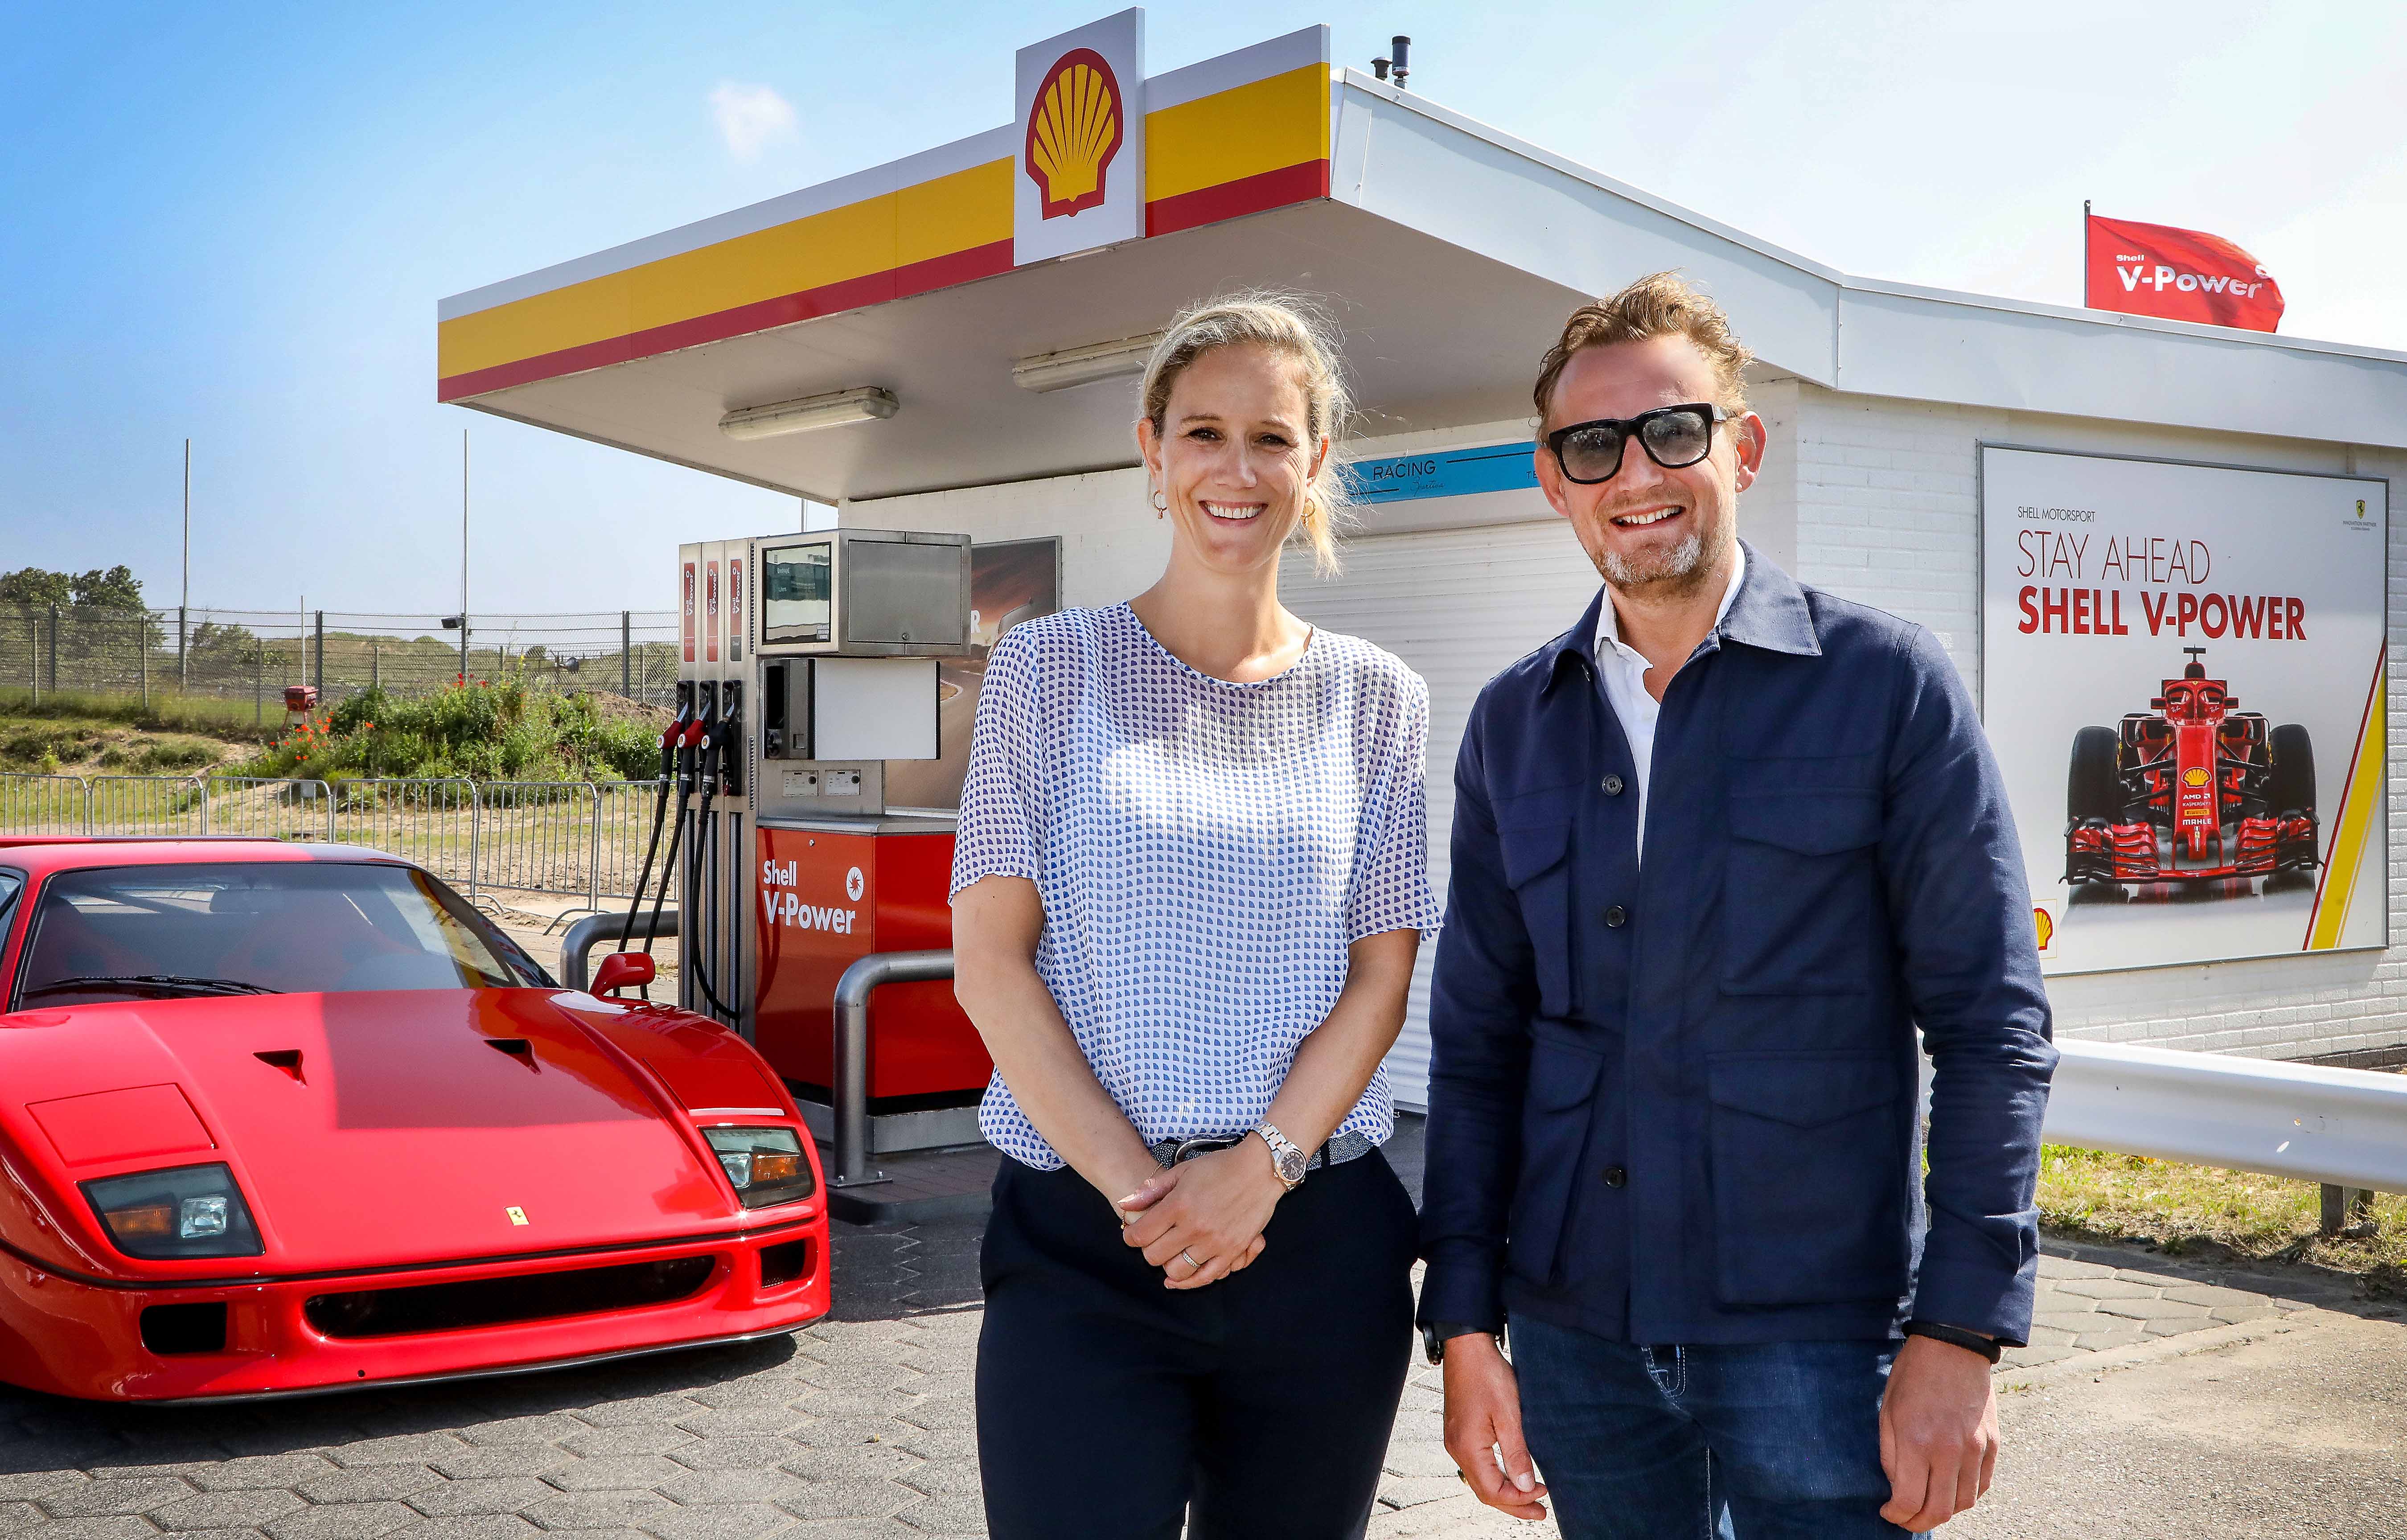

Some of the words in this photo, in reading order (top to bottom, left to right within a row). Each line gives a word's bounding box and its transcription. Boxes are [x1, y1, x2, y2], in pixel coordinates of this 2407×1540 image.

[2116, 266, 2263, 299] V-Power
[1373, 460, 1437, 481] RACING
[1526, 470, 1538, 479] TE
[2018, 506, 2040, 519] SHELL
[2041, 508, 2096, 522] MOTORSPORT
[2017, 529, 2090, 579] STAY
[2101, 534, 2210, 585] AHEAD
[2018, 584, 2128, 636] SHELL
[2140, 591, 2307, 641] V-POWER
[763, 859, 797, 887] Shell
[763, 890, 856, 934] V-Power
